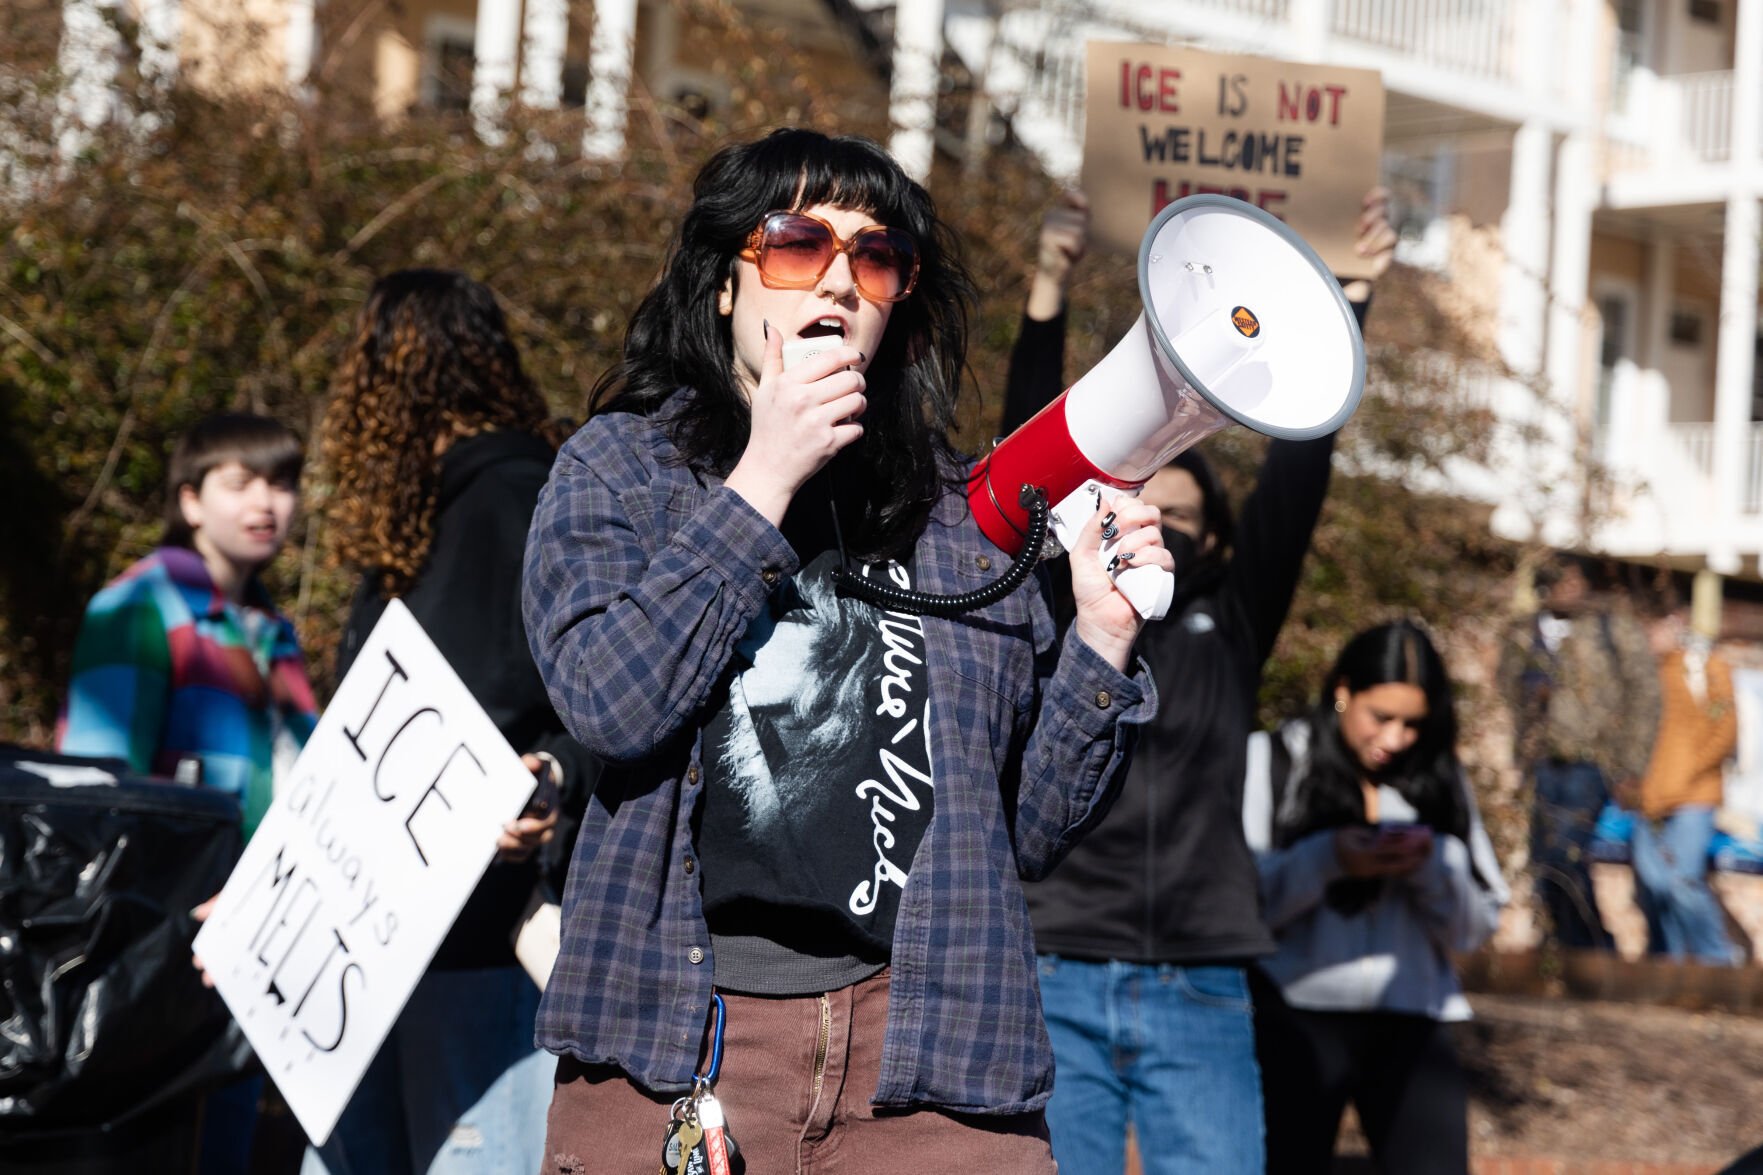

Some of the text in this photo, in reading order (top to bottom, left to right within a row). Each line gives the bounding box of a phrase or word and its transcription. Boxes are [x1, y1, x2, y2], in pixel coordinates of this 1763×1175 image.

[1119, 59, 1347, 127] ICE IS NOT
[1139, 124, 1303, 177] WELCOME
[1154, 179, 1287, 220] HE
[341, 649, 488, 867] ICE
[286, 773, 399, 946] always
[220, 845, 366, 1052] MELTS
